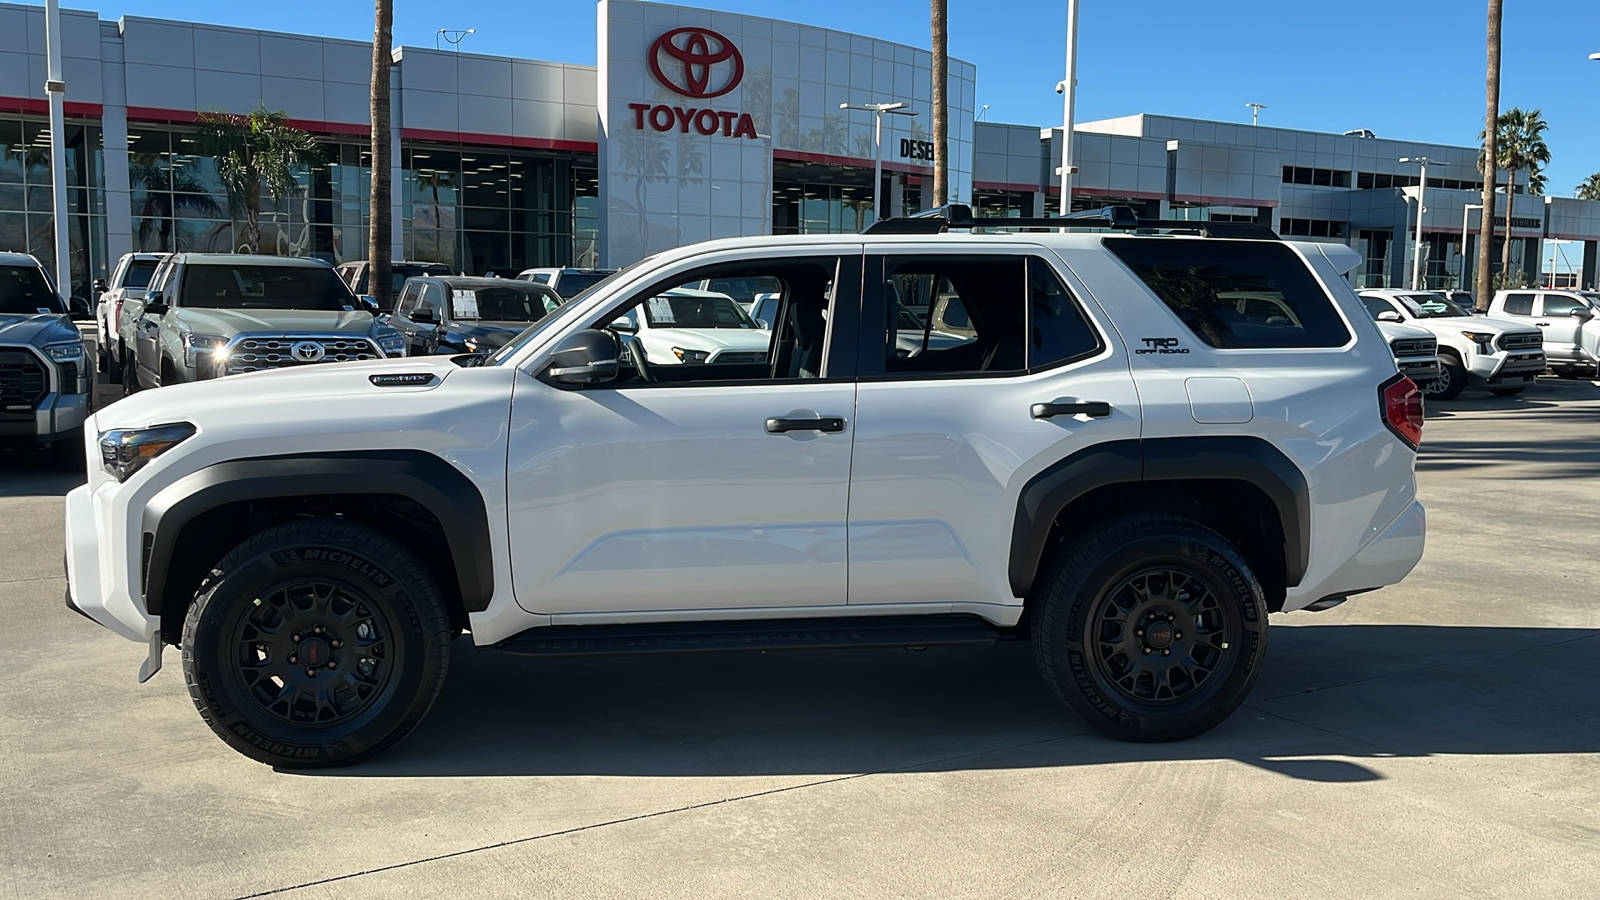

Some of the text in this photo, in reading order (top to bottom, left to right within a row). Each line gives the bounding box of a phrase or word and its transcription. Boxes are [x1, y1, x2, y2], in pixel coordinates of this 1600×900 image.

[628, 103, 758, 139] TOYOTA
[900, 138, 935, 161] DESE
[1142, 338, 1179, 349] TRD
[303, 549, 390, 586] MICHELIN
[1210, 554, 1256, 619] MICHELIN
[1151, 631, 1170, 639] TRD
[1070, 652, 1119, 718] MICHELIN
[233, 723, 320, 758] MICHELIN
